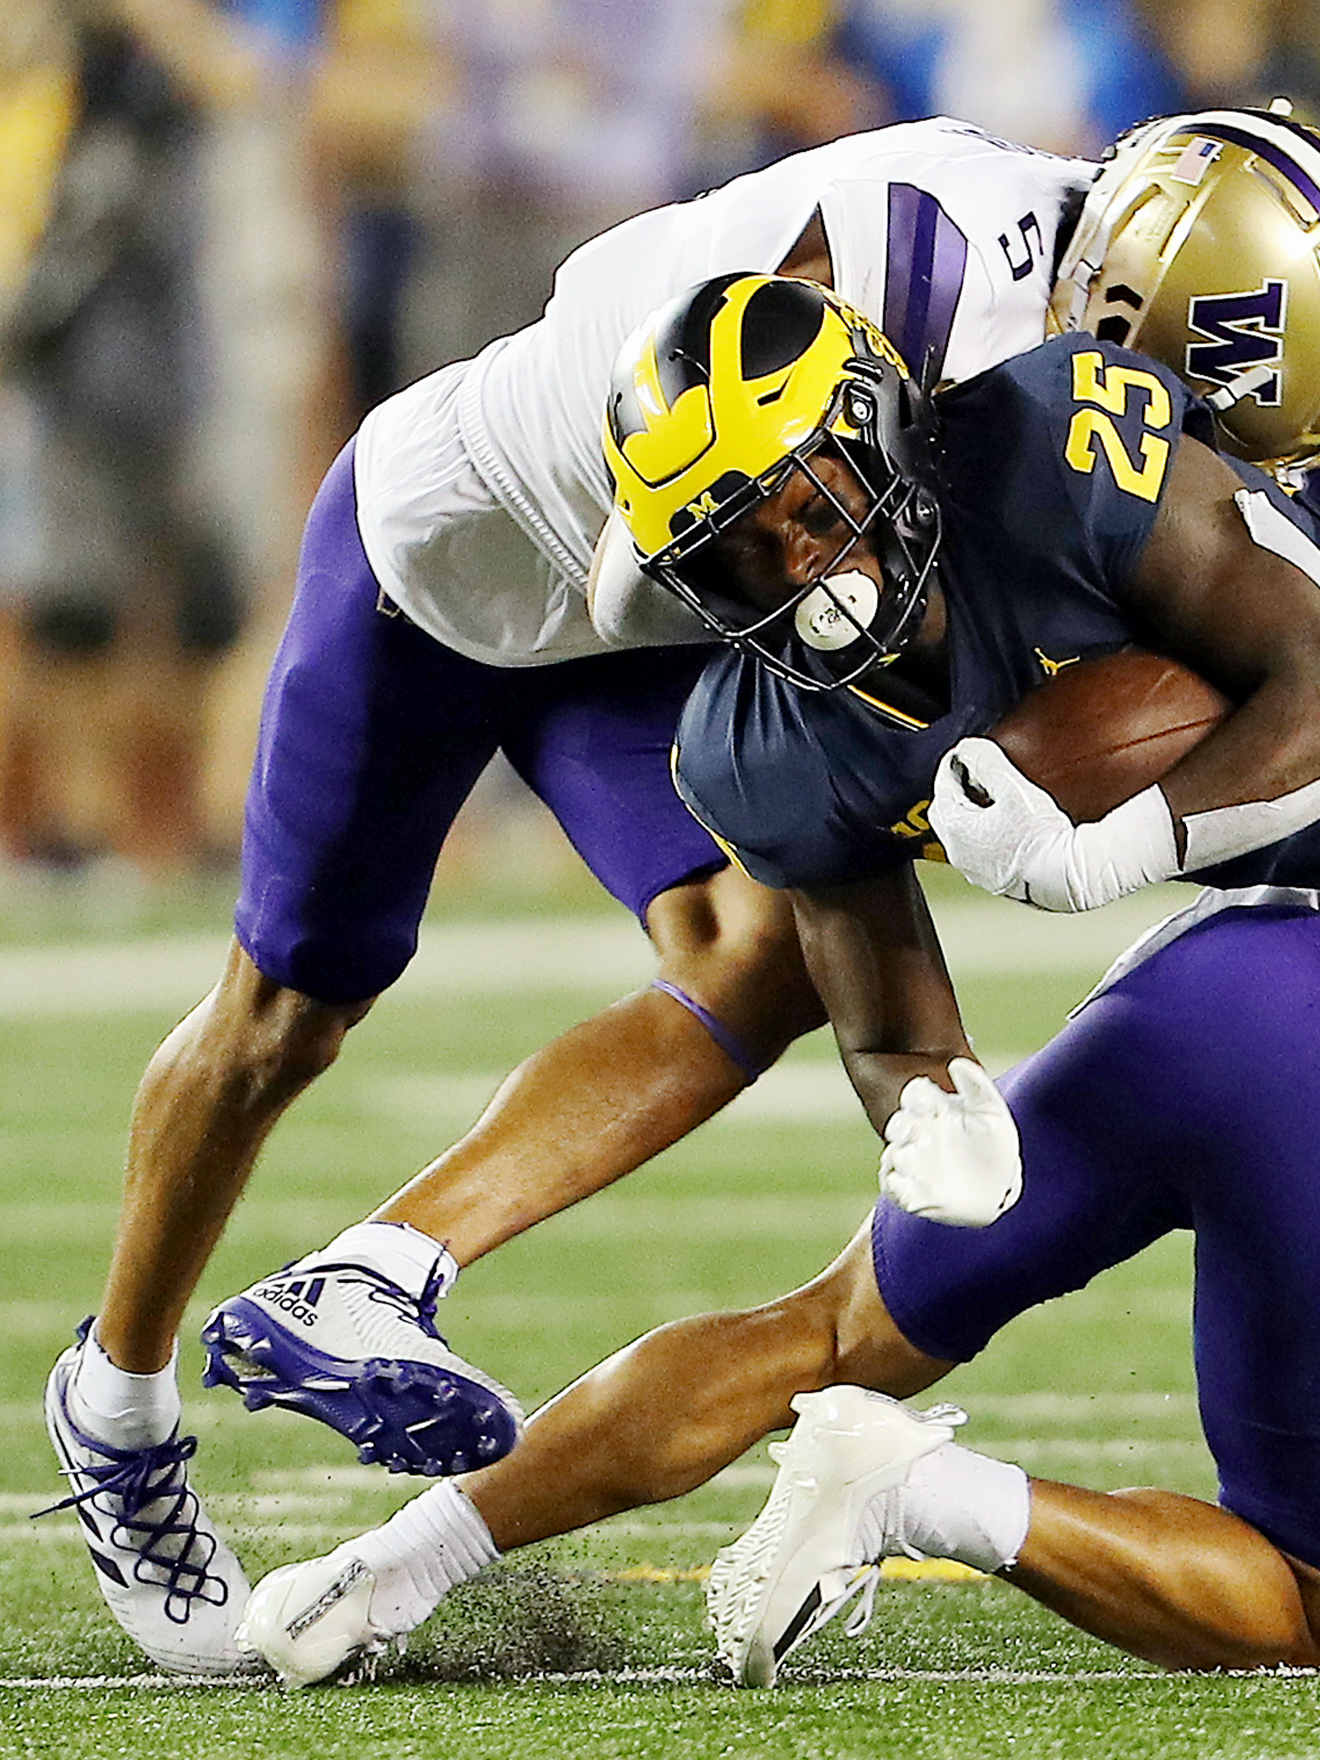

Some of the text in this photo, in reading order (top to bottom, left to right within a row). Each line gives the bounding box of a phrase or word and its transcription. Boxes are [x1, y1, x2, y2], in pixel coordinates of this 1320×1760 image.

[998, 211, 1044, 281] 5
[1185, 277, 1288, 407] W
[1064, 350, 1172, 504] 25
[686, 491, 720, 522] M
[253, 1287, 319, 1327] adidas
